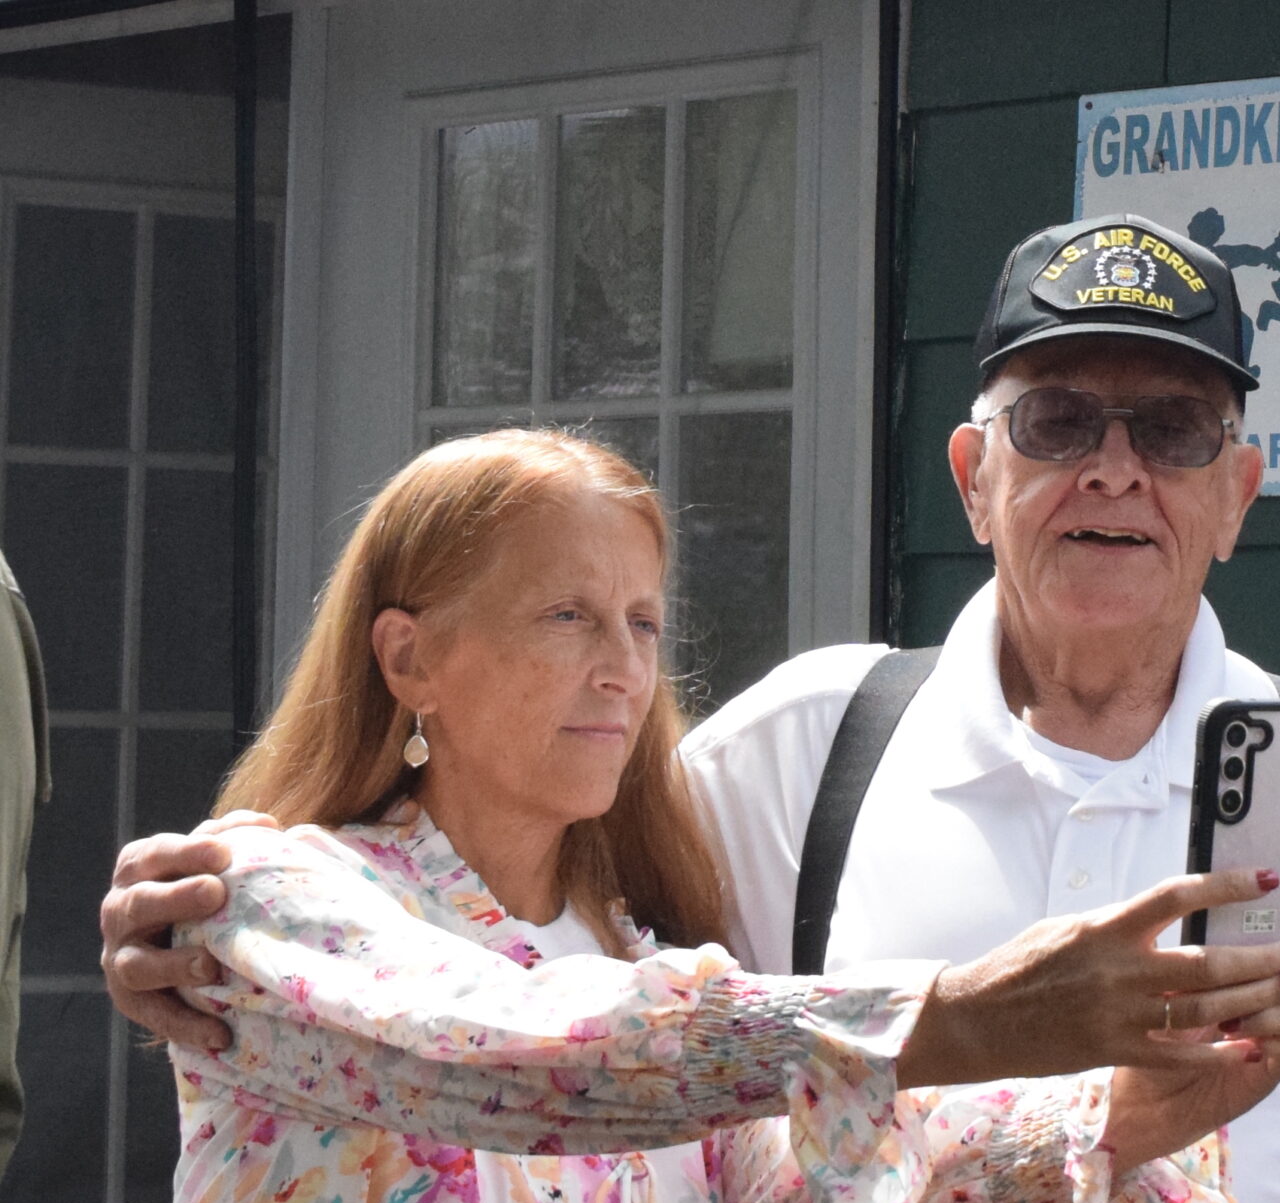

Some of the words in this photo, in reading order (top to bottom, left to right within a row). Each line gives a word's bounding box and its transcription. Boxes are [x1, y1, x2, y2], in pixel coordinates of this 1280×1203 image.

[1043, 244, 1089, 281] U.S.
[1094, 228, 1134, 249] AIR
[1139, 236, 1206, 293] FORCE
[1076, 286, 1173, 312] VETERAN
